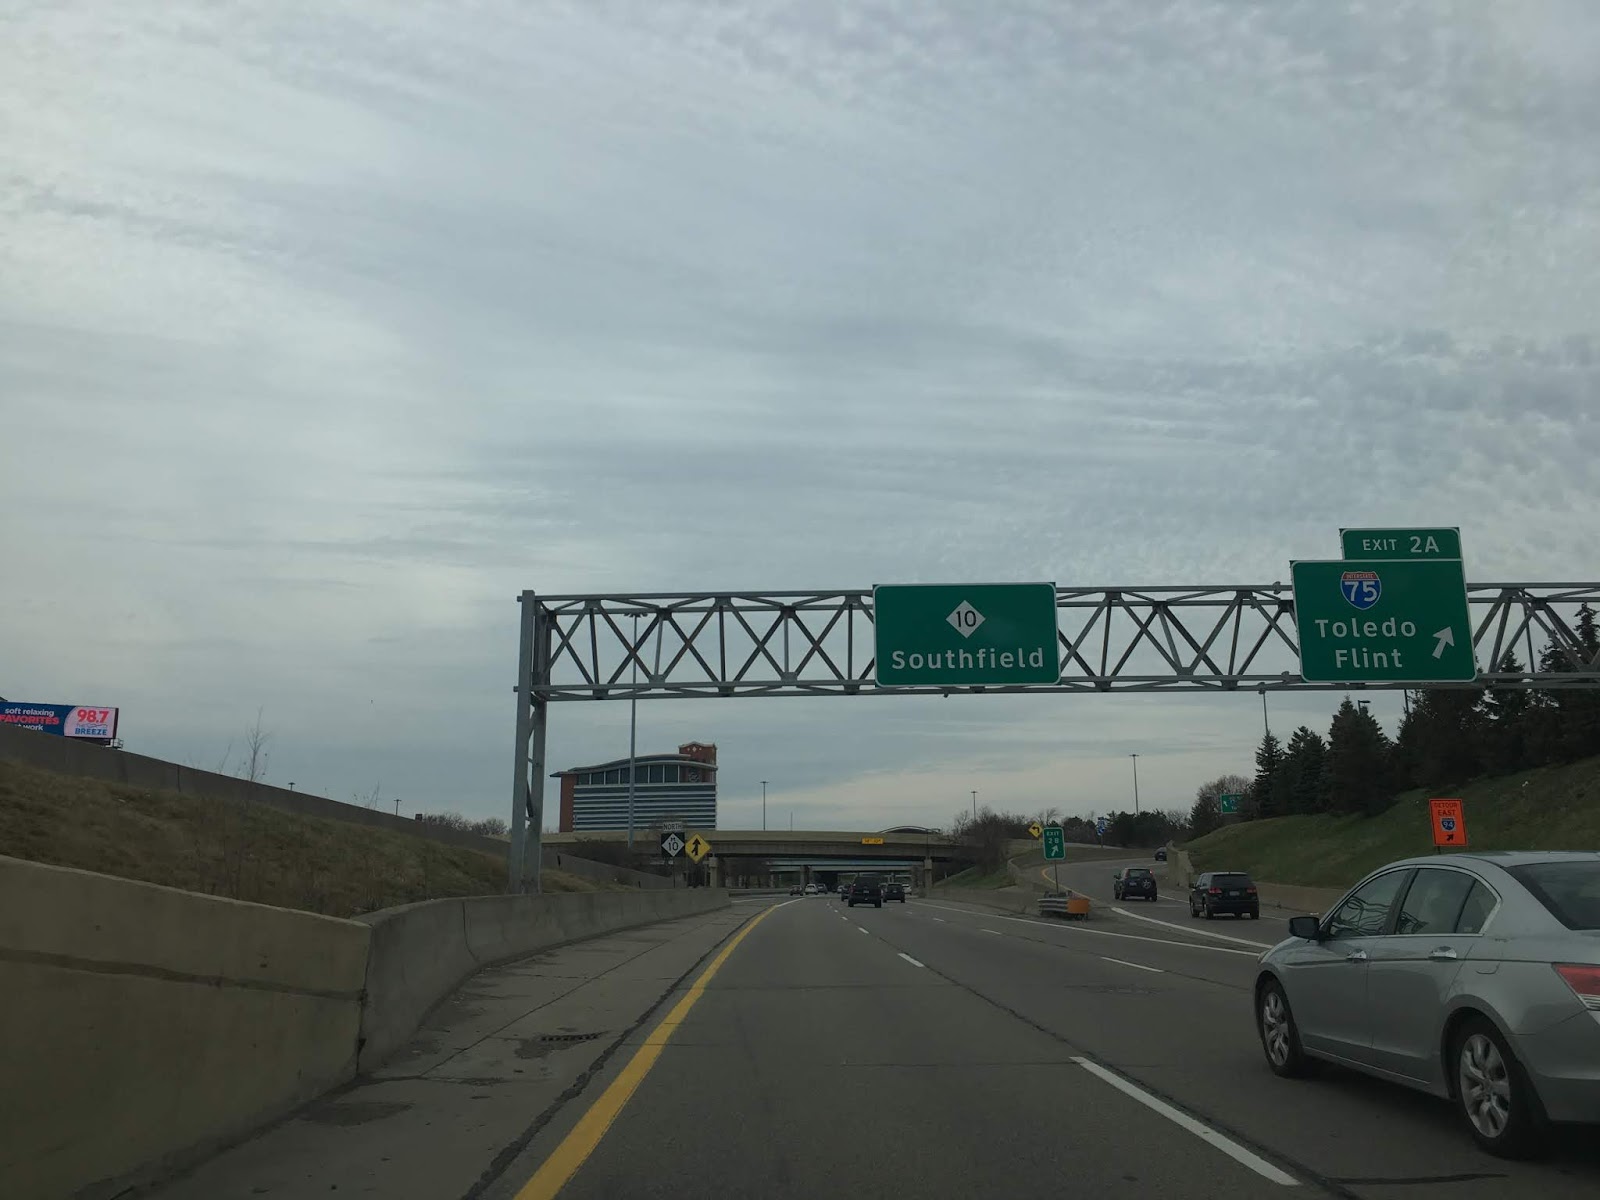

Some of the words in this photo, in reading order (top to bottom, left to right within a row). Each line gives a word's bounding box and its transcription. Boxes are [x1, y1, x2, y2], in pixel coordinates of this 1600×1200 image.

[1362, 539, 1397, 551] EXIT
[1409, 536, 1440, 553] 2A
[1344, 581, 1378, 602] 75
[955, 610, 977, 628] 10
[1315, 617, 1417, 638] Toledo
[892, 647, 1044, 670] Southfield
[1335, 648, 1403, 669] Flint
[0, 714, 60, 725] FAVORITES
[23, 708, 55, 718] relaxing
[77, 709, 109, 723] 98.7
[75, 728, 107, 736] BREEZE
[1442, 821, 1454, 829] 94
[668, 841, 679, 851] 10
